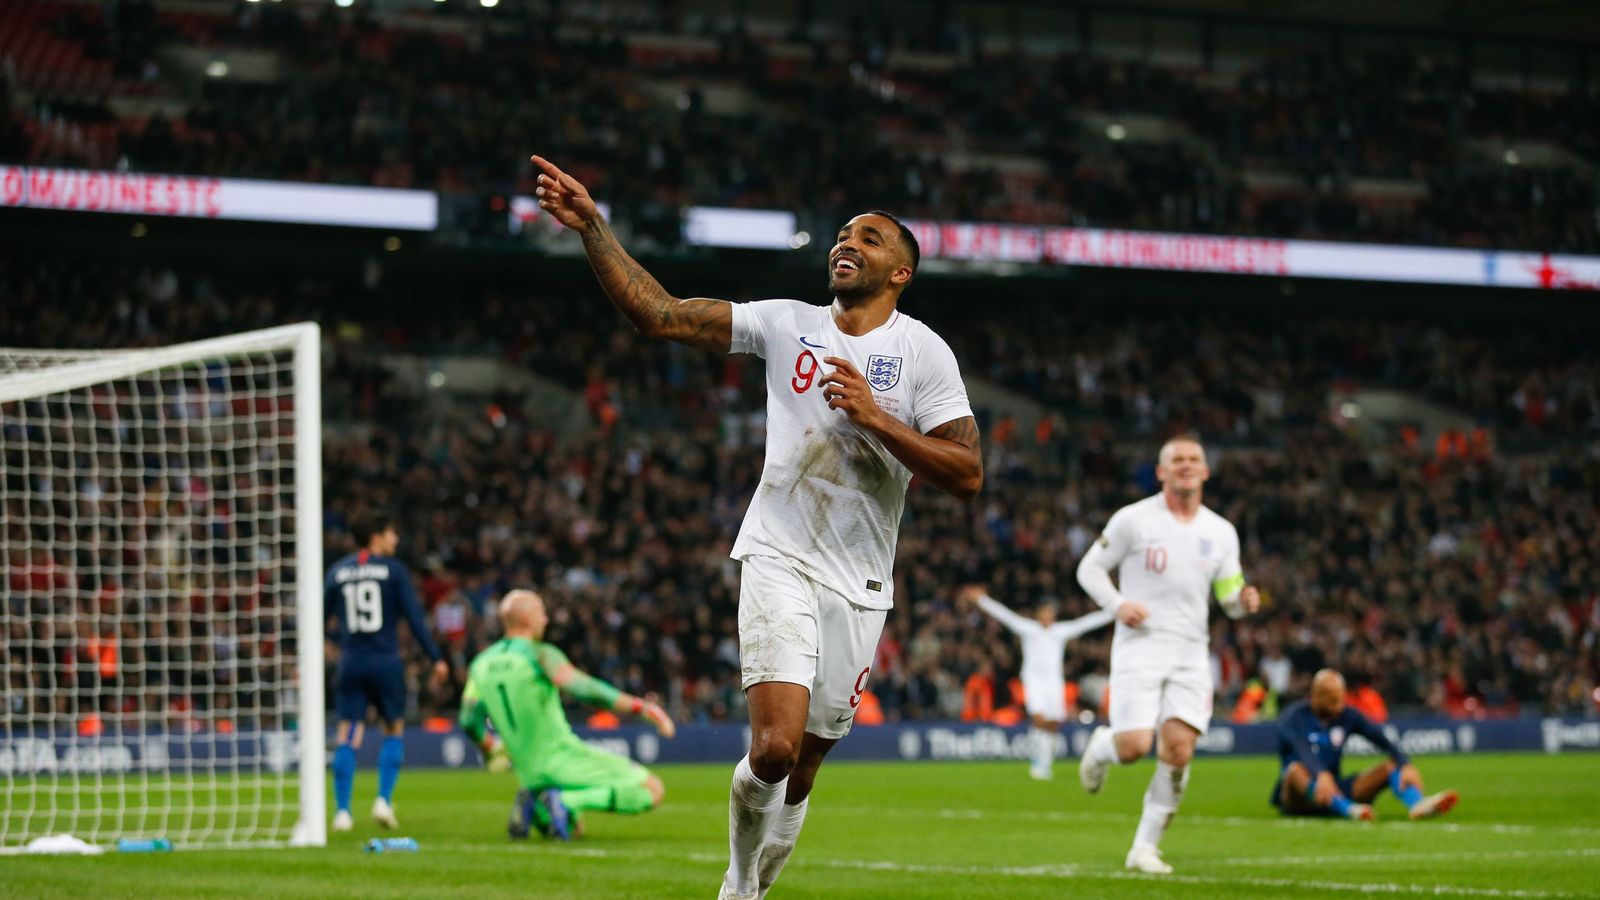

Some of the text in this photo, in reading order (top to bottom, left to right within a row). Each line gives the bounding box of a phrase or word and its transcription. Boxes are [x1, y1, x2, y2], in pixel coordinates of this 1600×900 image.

[791, 349, 818, 394] 9
[1145, 547, 1168, 574] 10
[341, 581, 383, 633] 19
[496, 683, 517, 732] 1
